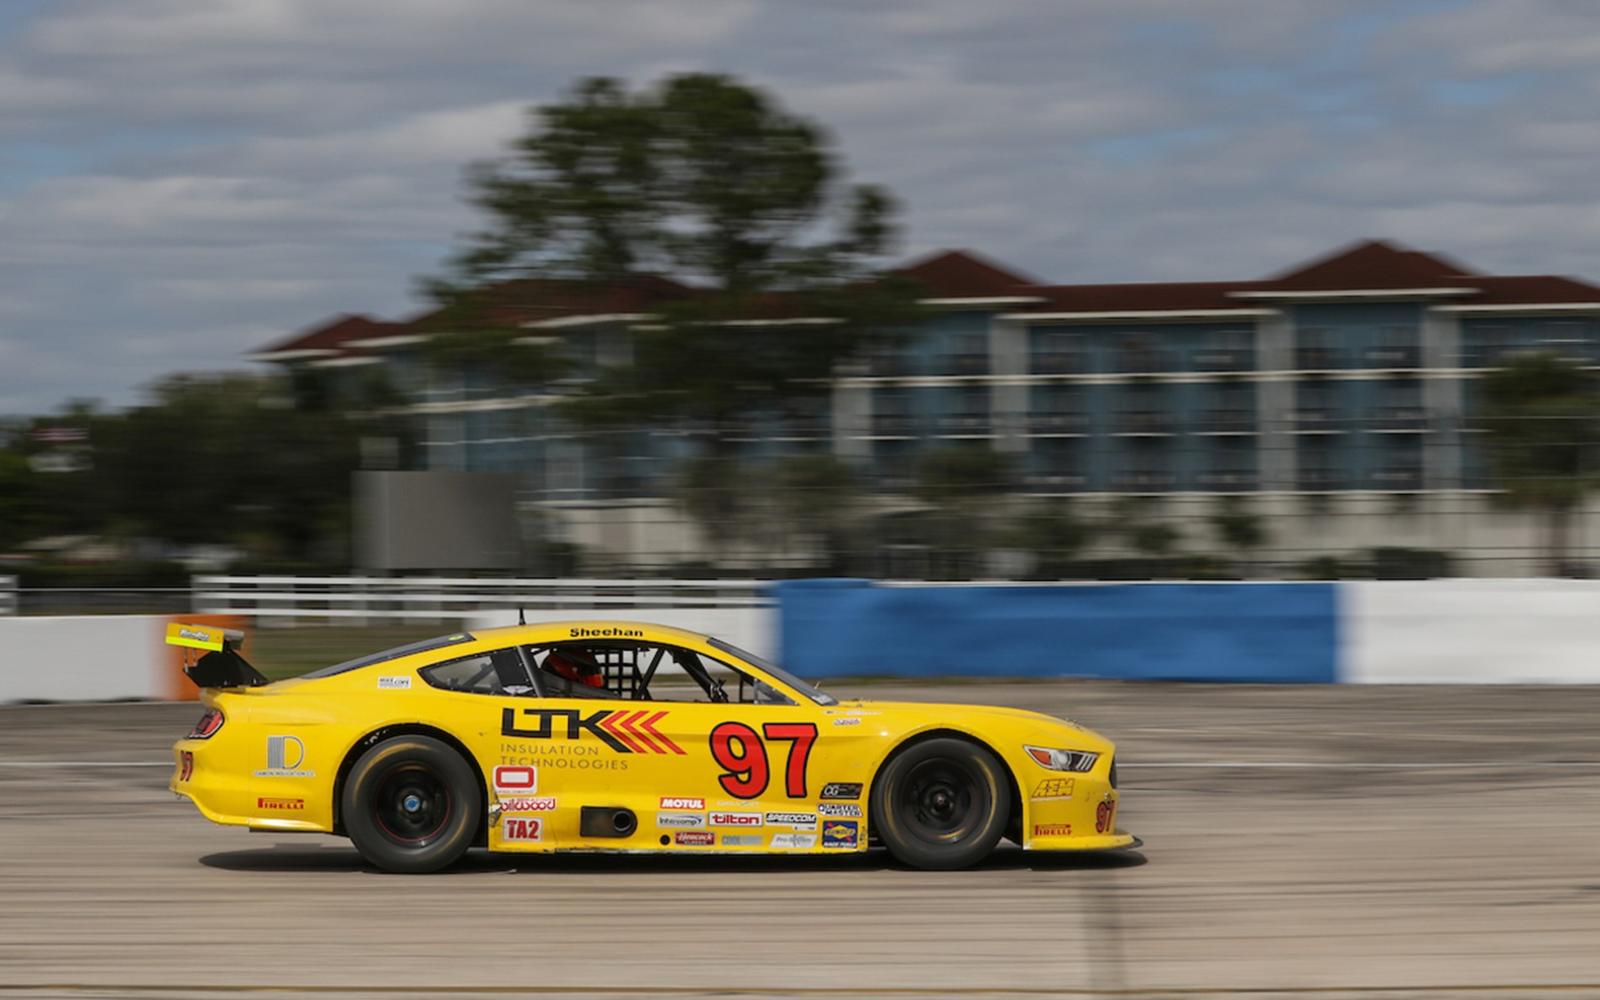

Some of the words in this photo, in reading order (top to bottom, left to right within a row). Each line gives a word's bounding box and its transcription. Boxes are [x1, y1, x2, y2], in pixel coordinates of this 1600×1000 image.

[569, 627, 644, 639] Sheehan
[500, 743, 599, 757] INSULATION
[500, 756, 629, 770] TECHNOLOGIES
[708, 721, 819, 800] 97
[257, 797, 304, 809] PIRELLI
[661, 798, 704, 809] MOTUL
[712, 813, 760, 825] tilton
[767, 813, 816, 823] SPEEDCOM
[1095, 800, 1115, 833] 97
[506, 820, 539, 839] TA2
[1034, 823, 1072, 836] PIRELLI
